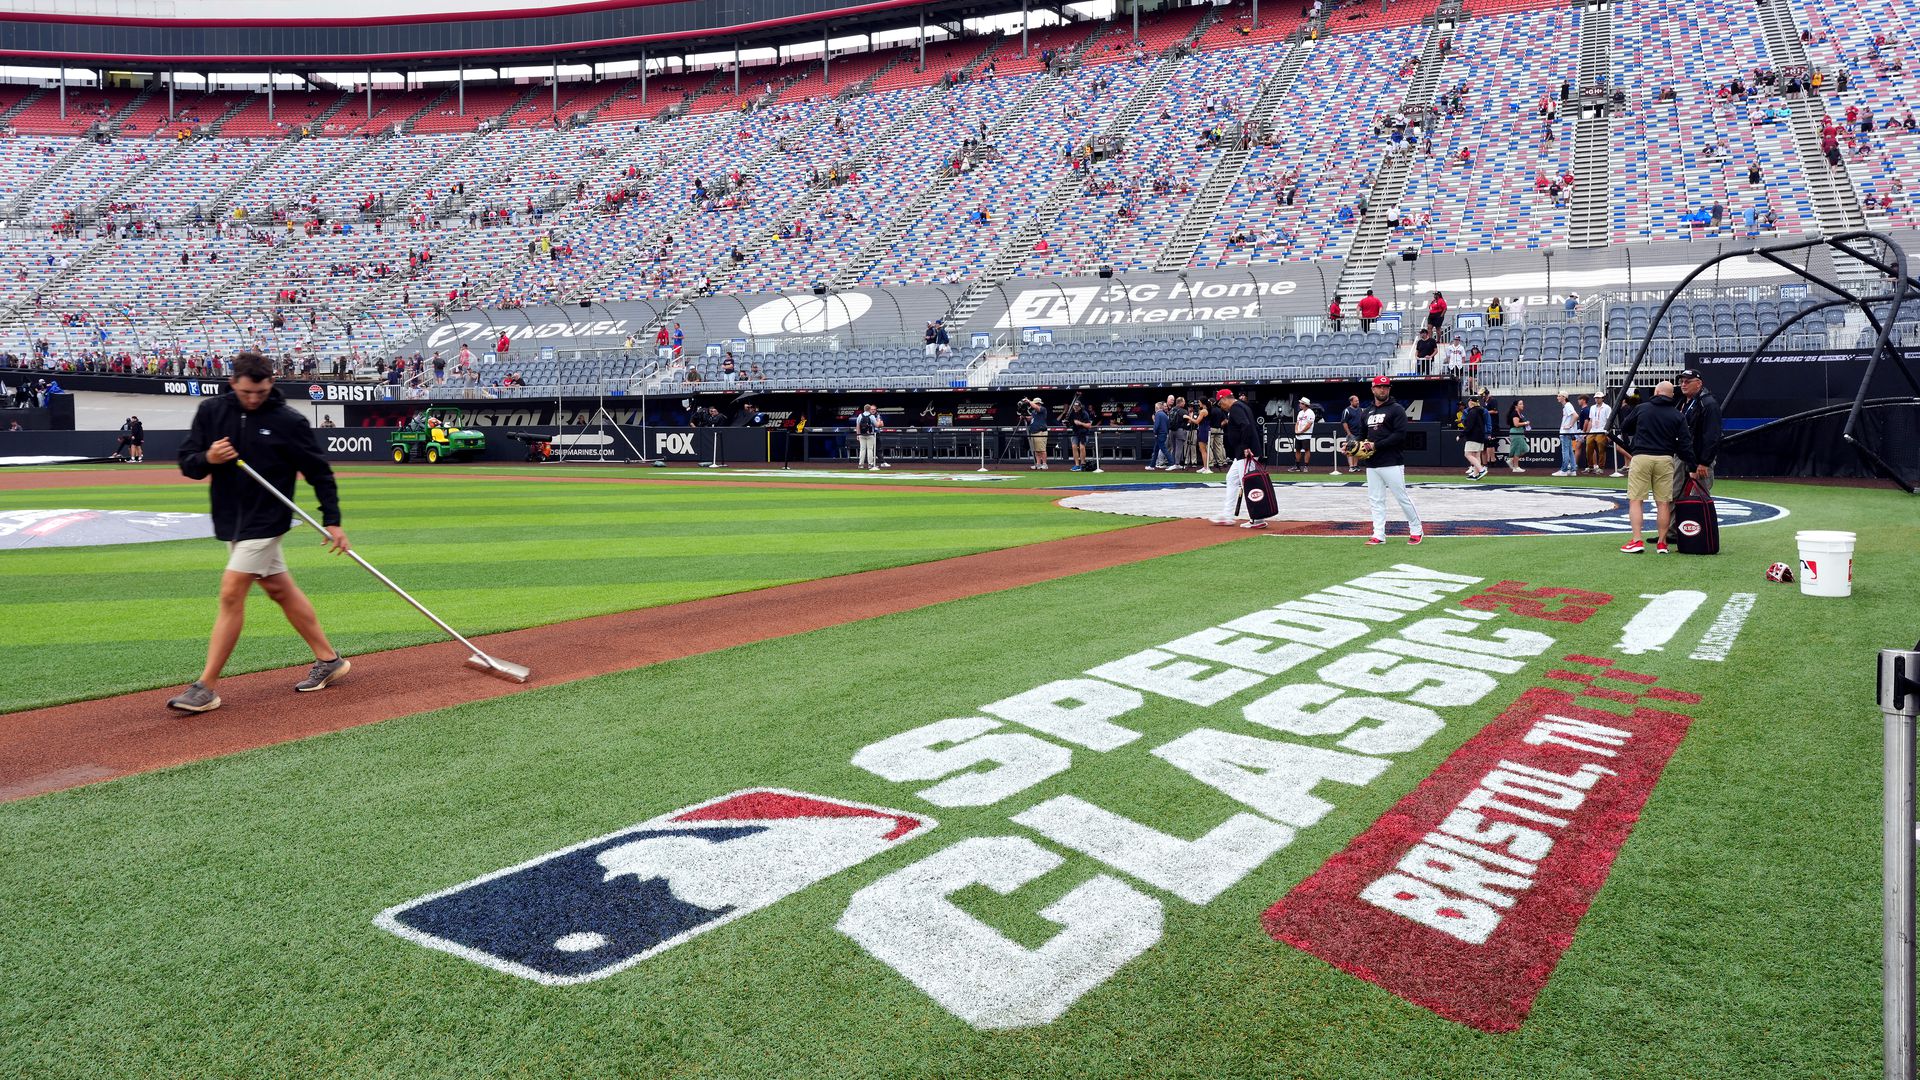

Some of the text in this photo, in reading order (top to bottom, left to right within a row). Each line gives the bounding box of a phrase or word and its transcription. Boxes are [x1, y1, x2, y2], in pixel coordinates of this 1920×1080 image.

[1101, 281, 1297, 302] 5G Home
[1085, 301, 1262, 325] Internet
[470, 319, 628, 342] FANDUEL
[1762, 355, 1804, 363] CLASSIC
[165, 382, 219, 395] FOOD CITY
[656, 433, 695, 455] FOX
[851, 563, 1485, 809] SPEEDWAY
[832, 616, 1556, 1031] CLASSIC
[1360, 758, 1617, 945] BRISTOL,
[1523, 714, 1633, 758] TN
